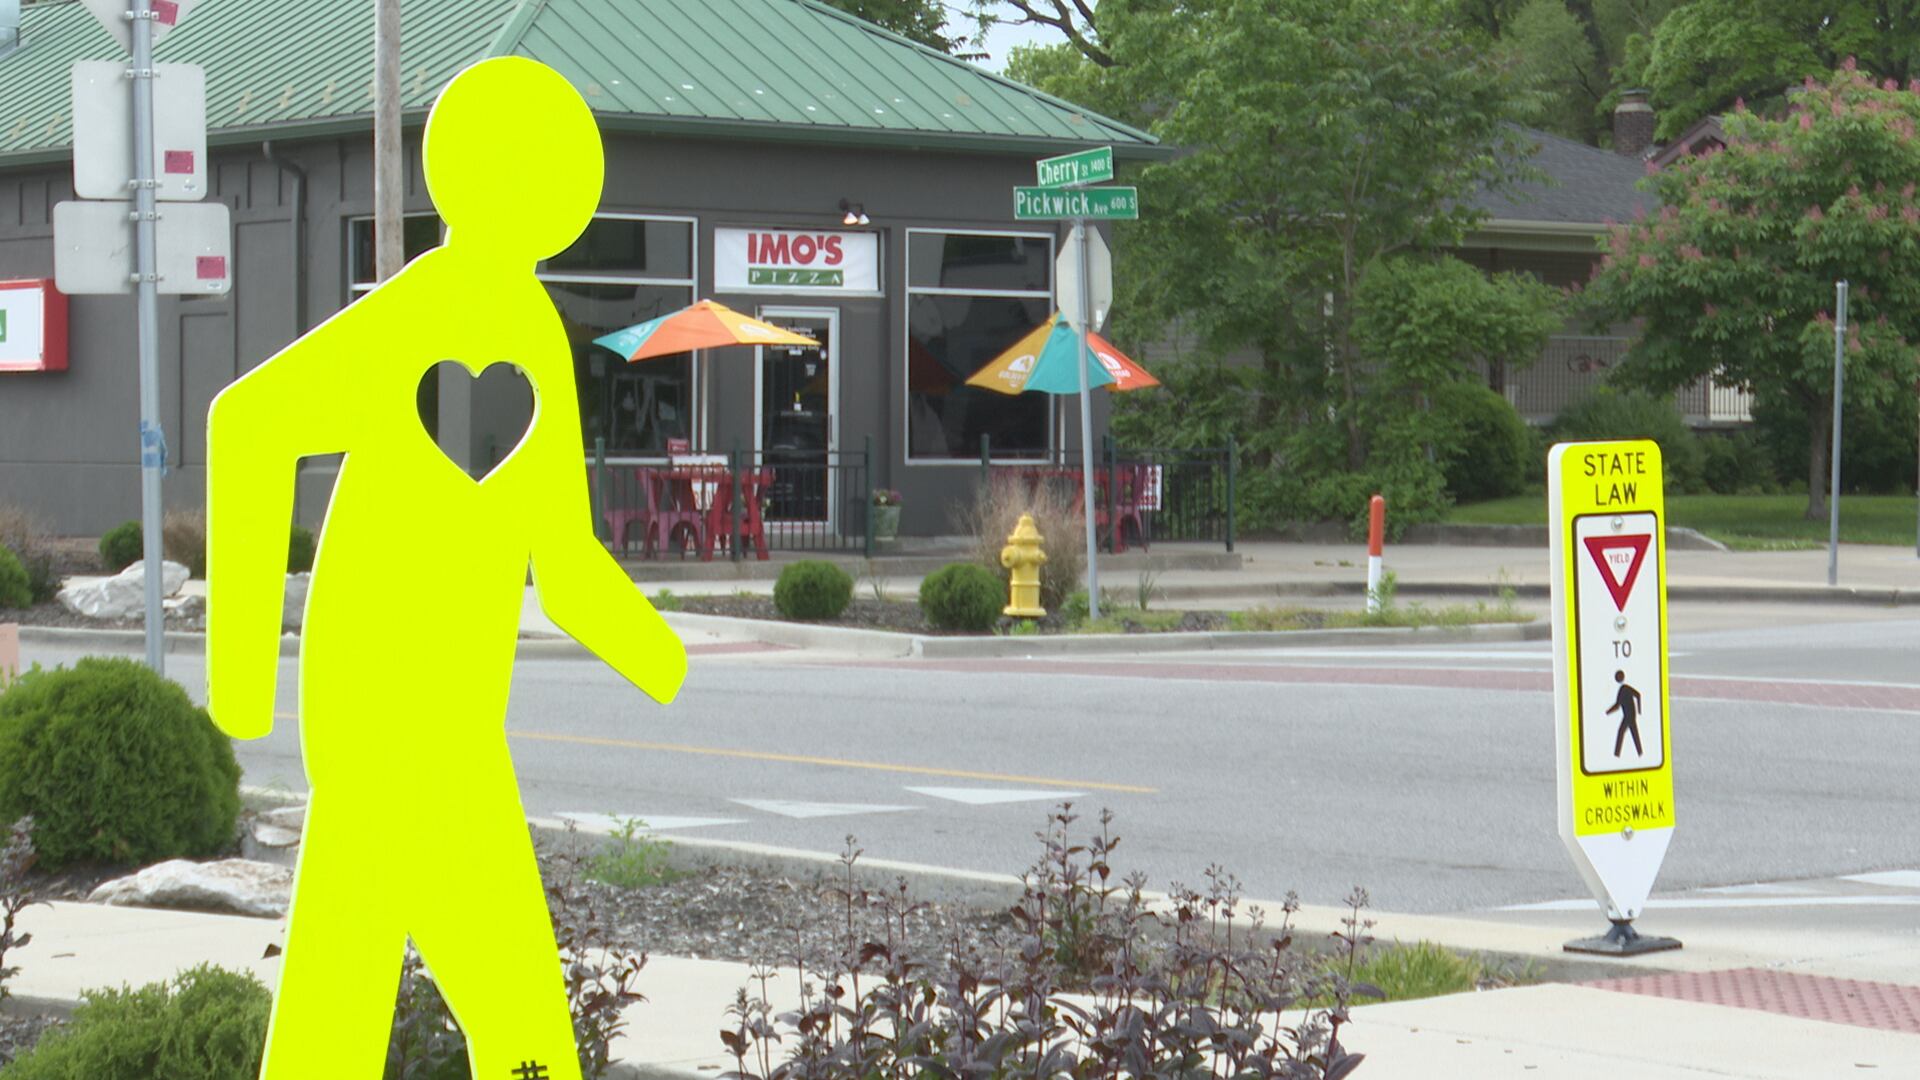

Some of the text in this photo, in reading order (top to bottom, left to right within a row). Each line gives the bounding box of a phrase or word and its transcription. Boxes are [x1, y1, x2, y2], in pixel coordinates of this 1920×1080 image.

[1039, 160, 1079, 185] Cherry
[1016, 191, 1136, 216] Pickwick Ave 600 S
[747, 232, 844, 266] IMO'S
[750, 270, 842, 284] PIZZA
[1583, 452, 1647, 477] STATE
[1595, 482, 1638, 507] LAW
[1608, 553, 1631, 564] YIELD
[1612, 639, 1632, 660] TO
[1603, 778, 1649, 800] WITHIN
[1585, 801, 1666, 826] CROSSWALK
